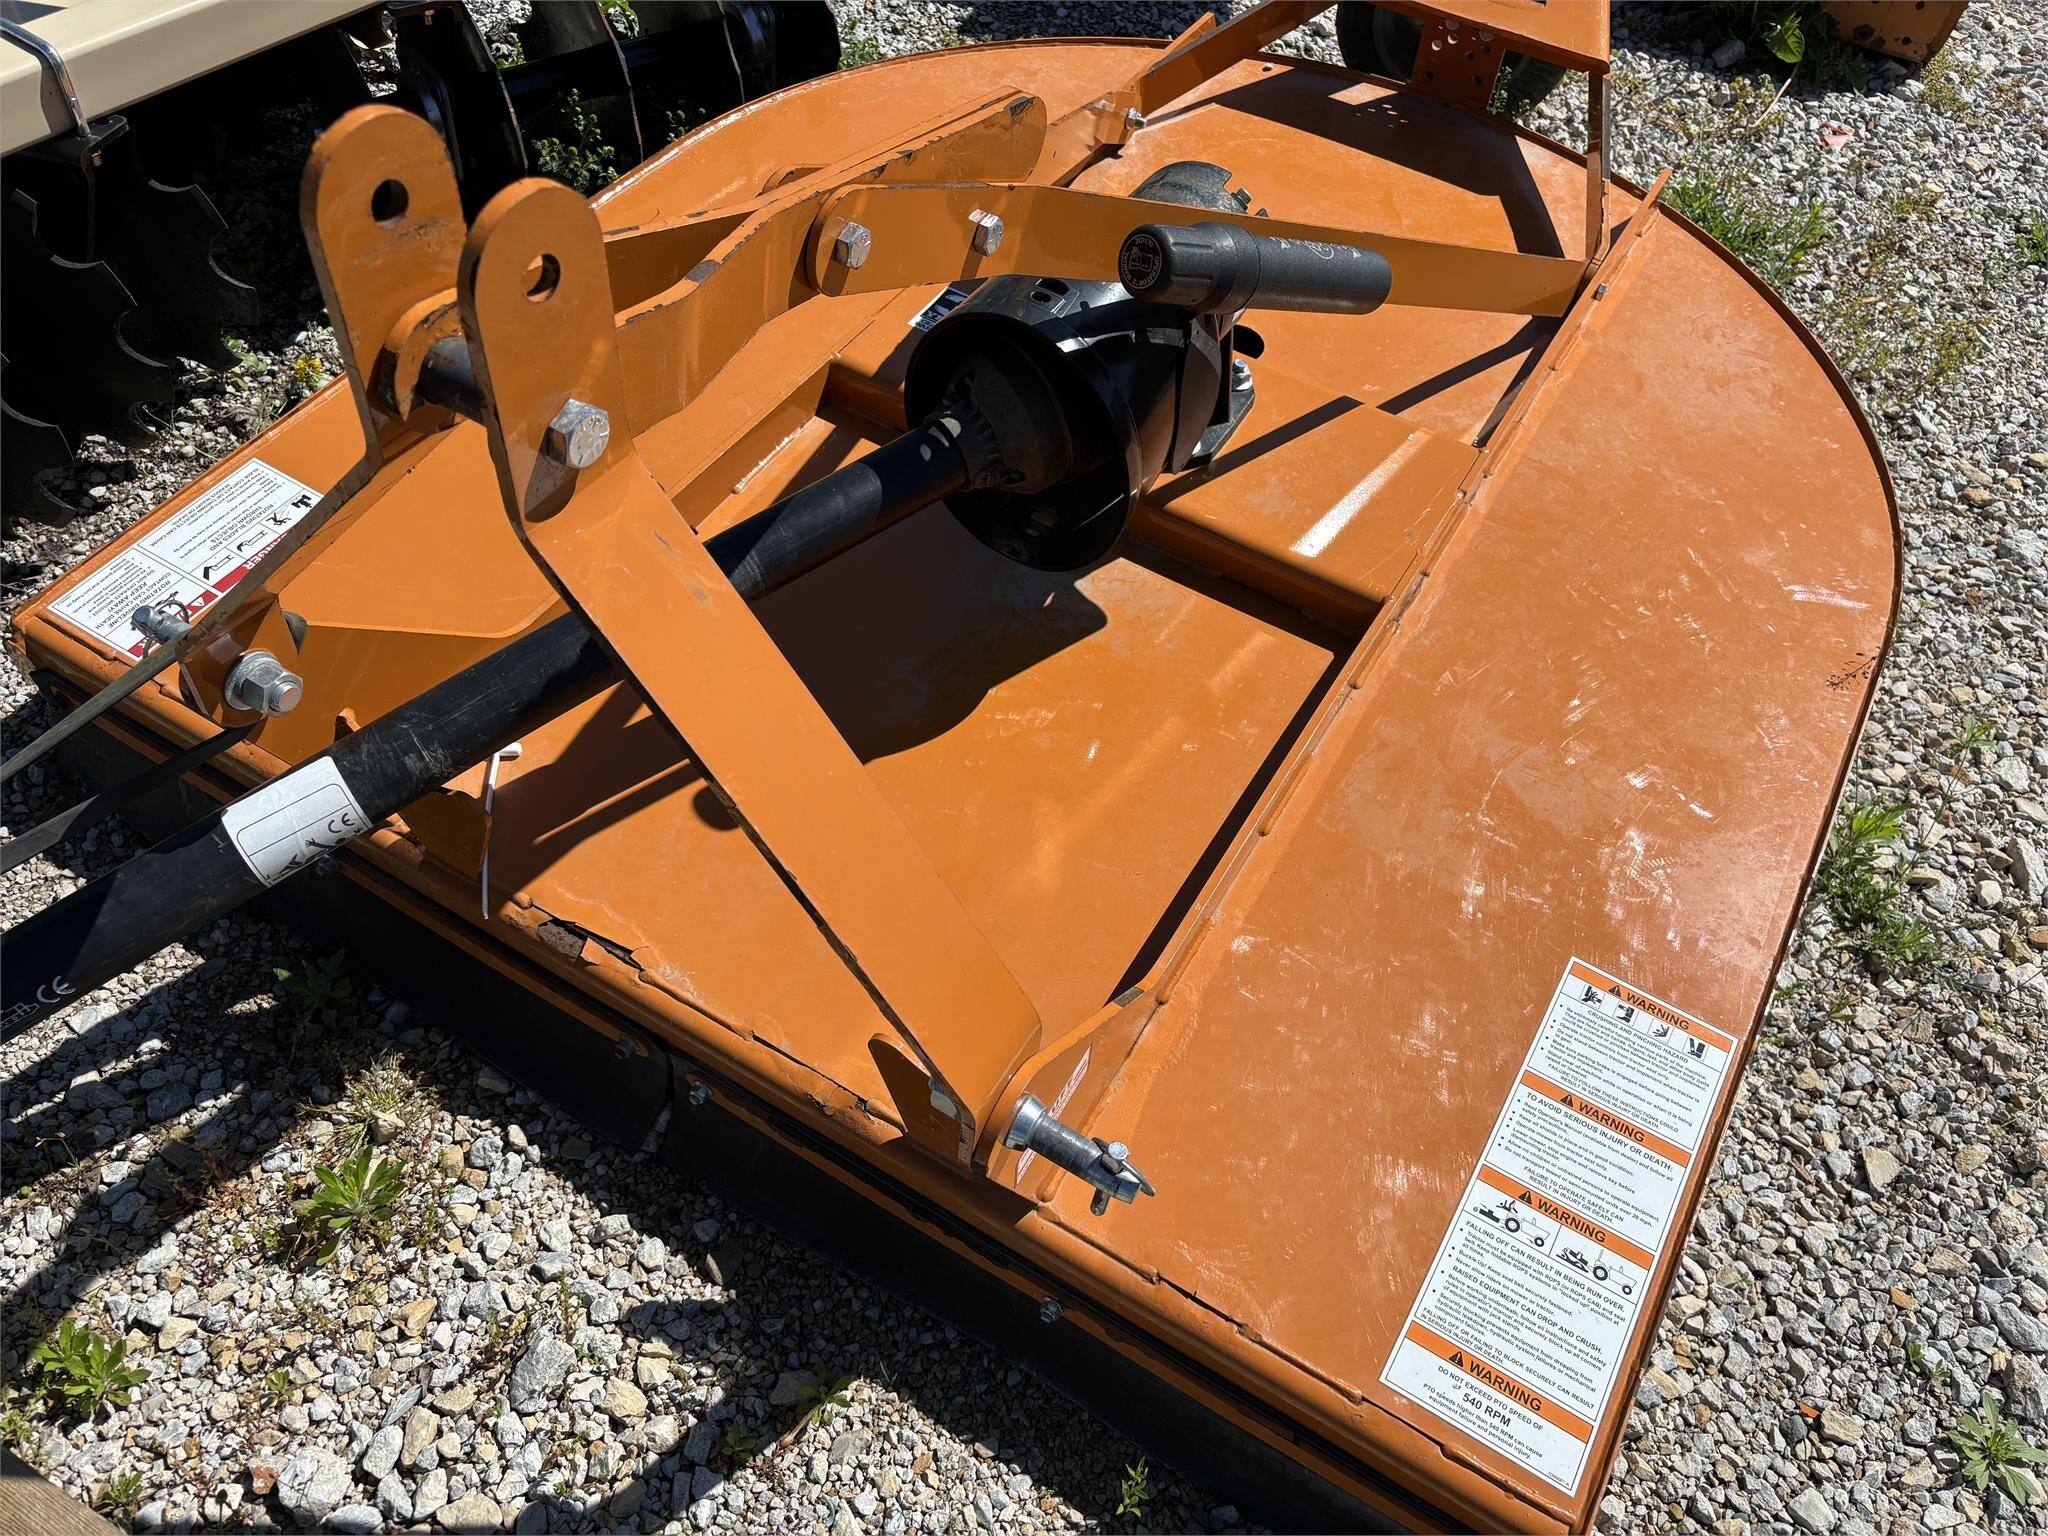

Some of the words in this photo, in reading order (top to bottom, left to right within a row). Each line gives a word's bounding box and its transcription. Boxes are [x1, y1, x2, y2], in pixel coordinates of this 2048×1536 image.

[242, 532, 288, 569] NGER
[327, 813, 355, 834] CE
[36, 975, 77, 1003] CE
[1625, 992, 1690, 1030] WARNING
[1587, 1009, 1618, 1028] CRUSHING
[1618, 1025, 1632, 1035] AND
[1632, 1032, 1662, 1050] PINCHING
[1662, 1047, 1688, 1063] HAZARD
[1548, 1063, 1570, 1077] FAILURE
[1578, 1078, 1601, 1093] FOLLOW
[1601, 1090, 1619, 1102] THESE
[1619, 1099, 1659, 1122] INSTRUCTIONS
[1658, 1119, 1678, 1132] COULD
[1560, 1075, 1580, 1088] RESULT
[1587, 1089, 1611, 1104] SERIOUS
[1611, 1101, 1630, 1114] INJURY
[1630, 1111, 1639, 1119] OR
[1577, 1101, 1645, 1142] WARNING
[1526, 1092, 1538, 1101] TO
[1537, 1098, 1562, 1114] AVOID
[1562, 1111, 1598, 1133] SERIOUS
[1598, 1129, 1628, 1148] INJURY
[1628, 1145, 1642, 1156] OR
[1642, 1152, 1673, 1172] DEATH:
[1524, 1165, 1549, 1182] FAILURE
[1558, 1183, 1586, 1201] OPERATE
[1586, 1198, 1610, 1214] SAFELY
[1609, 1211, 1623, 1221] CAN
[1529, 1175, 1552, 1190] RESULT
[1559, 1191, 1581, 1206] INJURY
[1581, 1203, 1591, 1211] OR
[1536, 1198, 1606, 1243] WARNING
[1466, 1220, 1495, 1240] FALLING
[1495, 1236, 1510, 1248] OFF
[1509, 1244, 1526, 1257] CAN
[1525, 1253, 1554, 1272] RESULT
[1553, 1268, 1562, 1277] IN
[1562, 1273, 1585, 1290] BEING
[1585, 1286, 1602, 1299] RUN
[1602, 1295, 1625, 1312] OVER.
[1427, 1316, 1452, 1334] SERIOUS
[1452, 1330, 1473, 1346] INJURY
[1473, 1343, 1483, 1351] OR
[1452, 1264, 1479, 1283] RAISED
[1478, 1279, 1520, 1307] EQUIPMENT
[1520, 1303, 1536, 1316] CAN
[1536, 1312, 1558, 1328] DROP
[1557, 1324, 1574, 1338] AND
[1574, 1334, 1603, 1354] CRUSH.
[1423, 1306, 1447, 1323] FALLING
[1447, 1320, 1460, 1331] OFF
[1459, 1328, 1470, 1337] OR
[1469, 1333, 1493, 1350] FAILING
[1493, 1347, 1503, 1356] TO
[1502, 1352, 1524, 1368] BLOCK
[1524, 1365, 1556, 1387] SECURELY
[1556, 1384, 1570, 1395] CAN
[1570, 1392, 1594, 1409] RESULT
[1437, 1365, 1449, 1376] DO
[1449, 1372, 1464, 1384] NOT
[1464, 1380, 1493, 1401] EXCEED
[1492, 1397, 1508, 1410] PTO
[1507, 1406, 1532, 1425] SPEED
[1532, 1421, 1543, 1431] OF
[1462, 1392, 1483, 1410] 540
[1483, 1404, 1511, 1426] RPM
[1468, 1360, 1542, 1412] WARNING
[1423, 1382, 1436, 1393] PTO
[1435, 1390, 1456, 1407] speeds
[1455, 1402, 1475, 1418] higher
[1474, 1413, 1488, 1425] than
[1488, 1421, 1499, 1431] 540
[1499, 1428, 1514, 1440] RPM
[1513, 1437, 1525, 1447] can
[1525, 1444, 1542, 1457] cause
[1428, 1394, 1458, 1416] equipment
[1457, 1411, 1476, 1426] failure
[1476, 1422, 1488, 1433] and
[1487, 1429, 1513, 1449] personal
